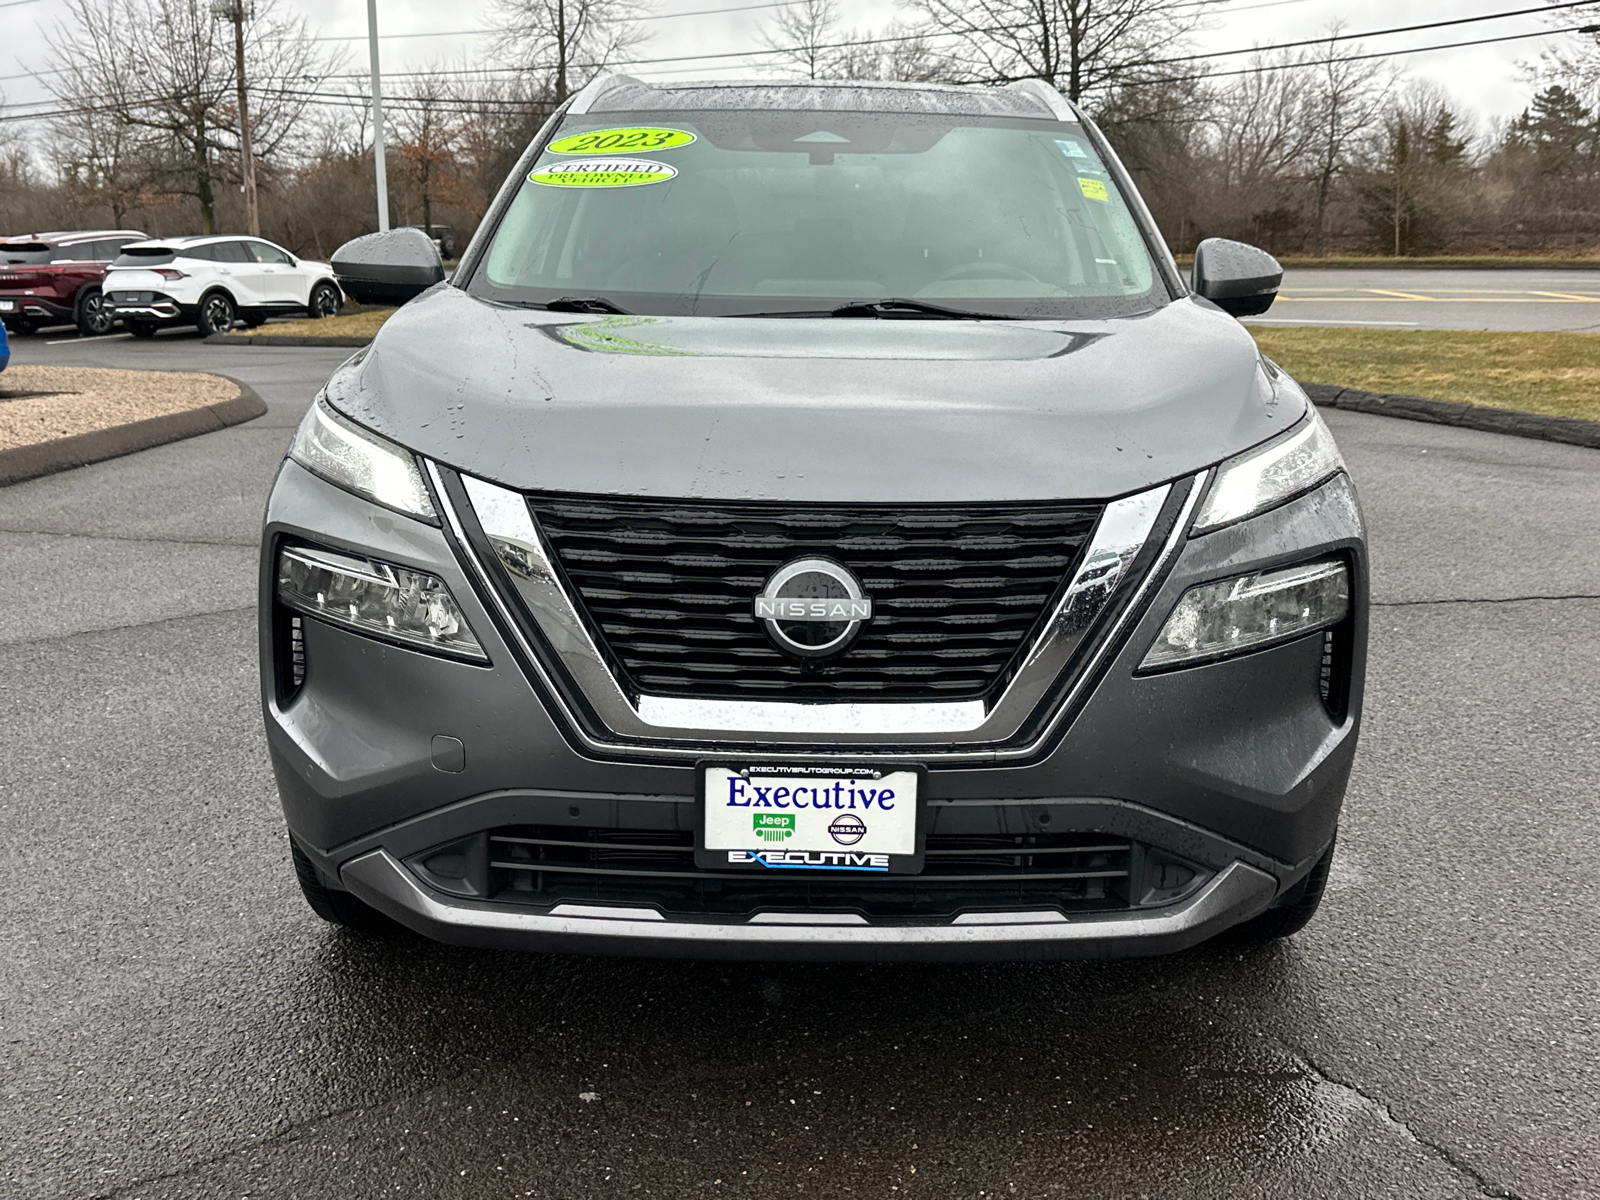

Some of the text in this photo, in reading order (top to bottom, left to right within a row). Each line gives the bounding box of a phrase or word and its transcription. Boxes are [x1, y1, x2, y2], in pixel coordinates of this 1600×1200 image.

[567, 132, 674, 151] 2023
[548, 164, 663, 173] CERTIFIED
[759, 602, 867, 616] NISSAN
[749, 766, 874, 775] EXECUTIVEAUTOGROUP.COM
[726, 777, 895, 810] Executive
[759, 815, 790, 827] Jeep
[830, 826, 865, 834] NISSAN
[728, 851, 889, 867] EXECUTIVE
